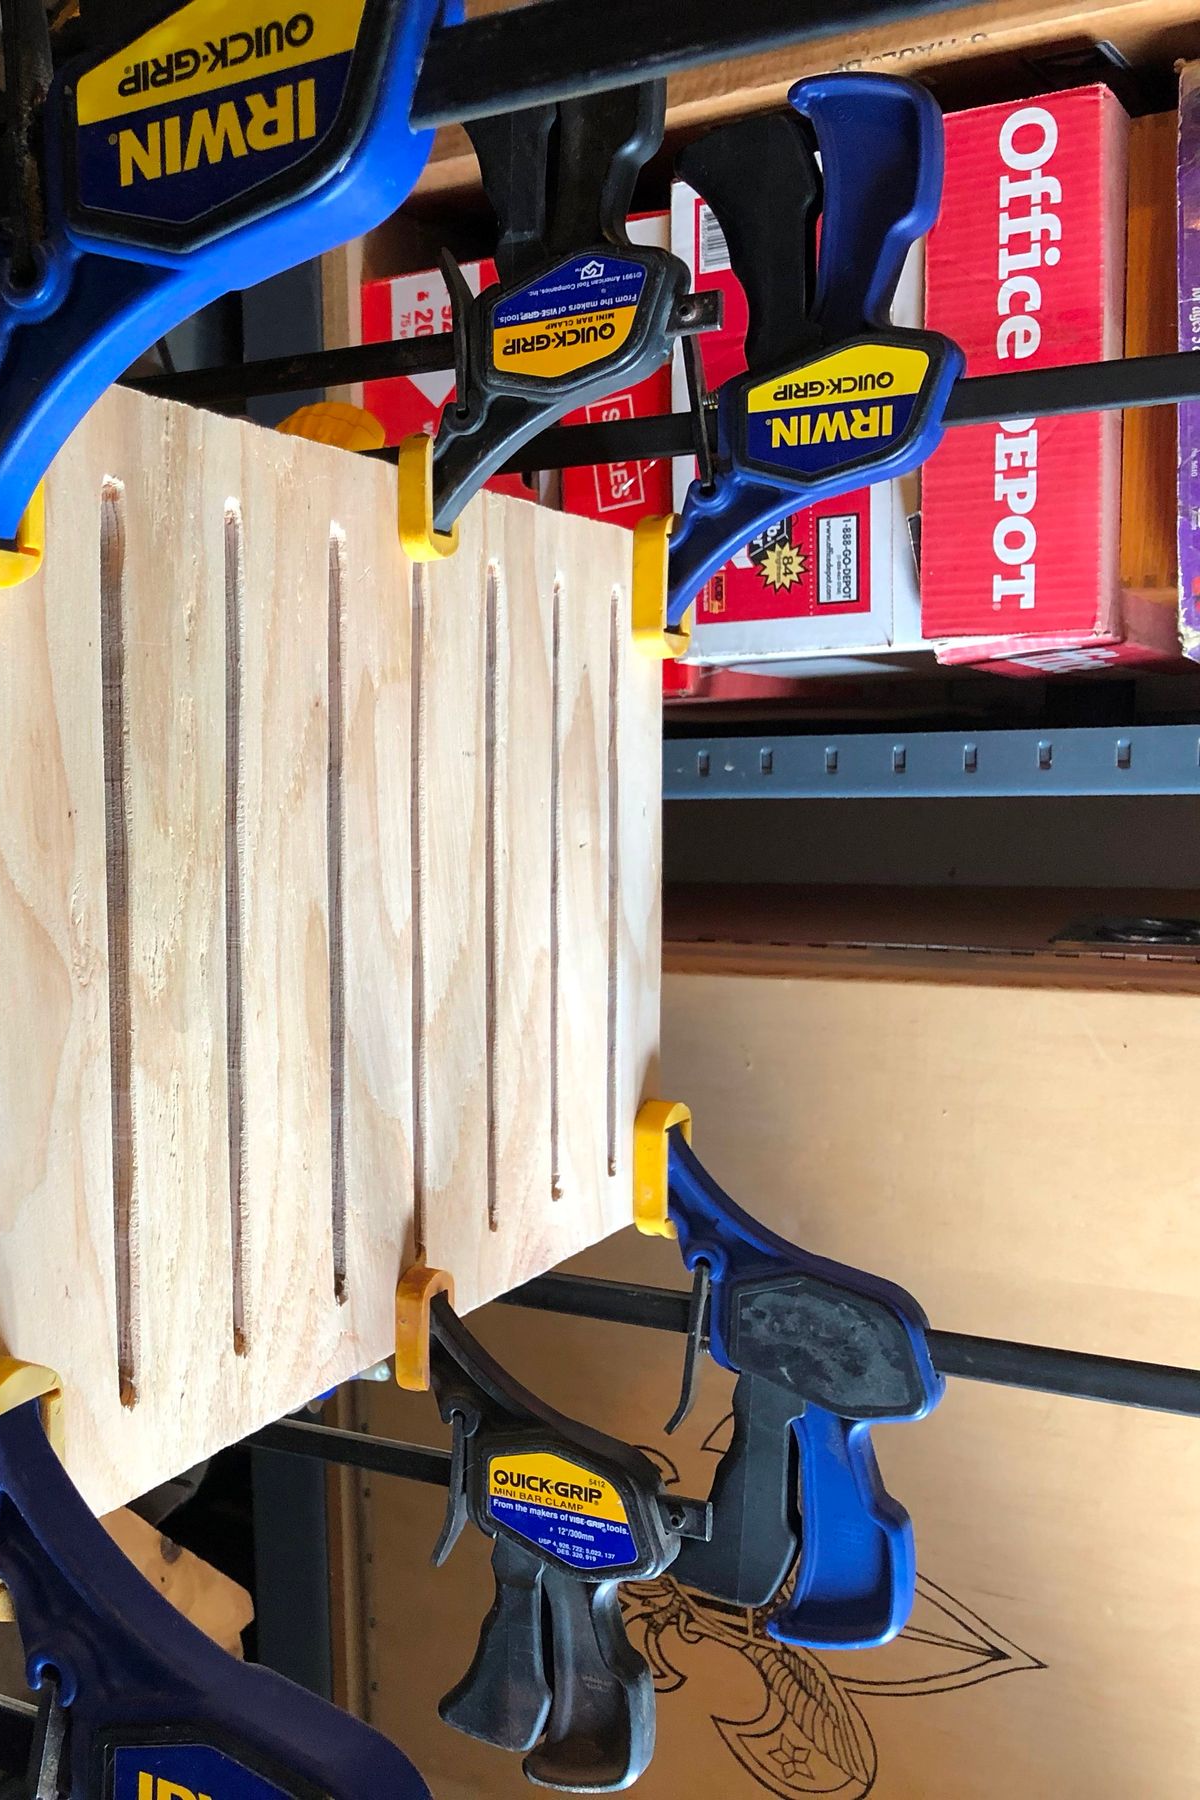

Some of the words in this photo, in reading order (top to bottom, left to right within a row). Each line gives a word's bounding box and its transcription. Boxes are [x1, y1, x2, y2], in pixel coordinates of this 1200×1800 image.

[119, 78, 316, 187] IRWIN
[996, 106, 1062, 360] Office
[576, 280, 591, 288] Tool
[590, 275, 621, 286] American
[600, 297, 614, 306] the
[615, 293, 637, 303] From
[559, 306, 567, 314] of
[569, 300, 598, 312] makers
[576, 316, 593, 325] BAR
[595, 312, 615, 321] MINI
[545, 320, 573, 330] CLAMP
[771, 404, 893, 448] IRWIN
[842, 518, 852, 599] 1-888-GO-DEPOT
[783, 555, 794, 576] 84
[493, 1487, 516, 1497] MINI
[519, 1492, 541, 1502] BAR
[545, 1497, 584, 1512] CLAMP
[493, 1498, 514, 1510] From
[515, 1503, 528, 1513] the
[529, 1507, 558, 1519] makers
[560, 1512, 569, 1521] of
[606, 1523, 629, 1535] tools.
